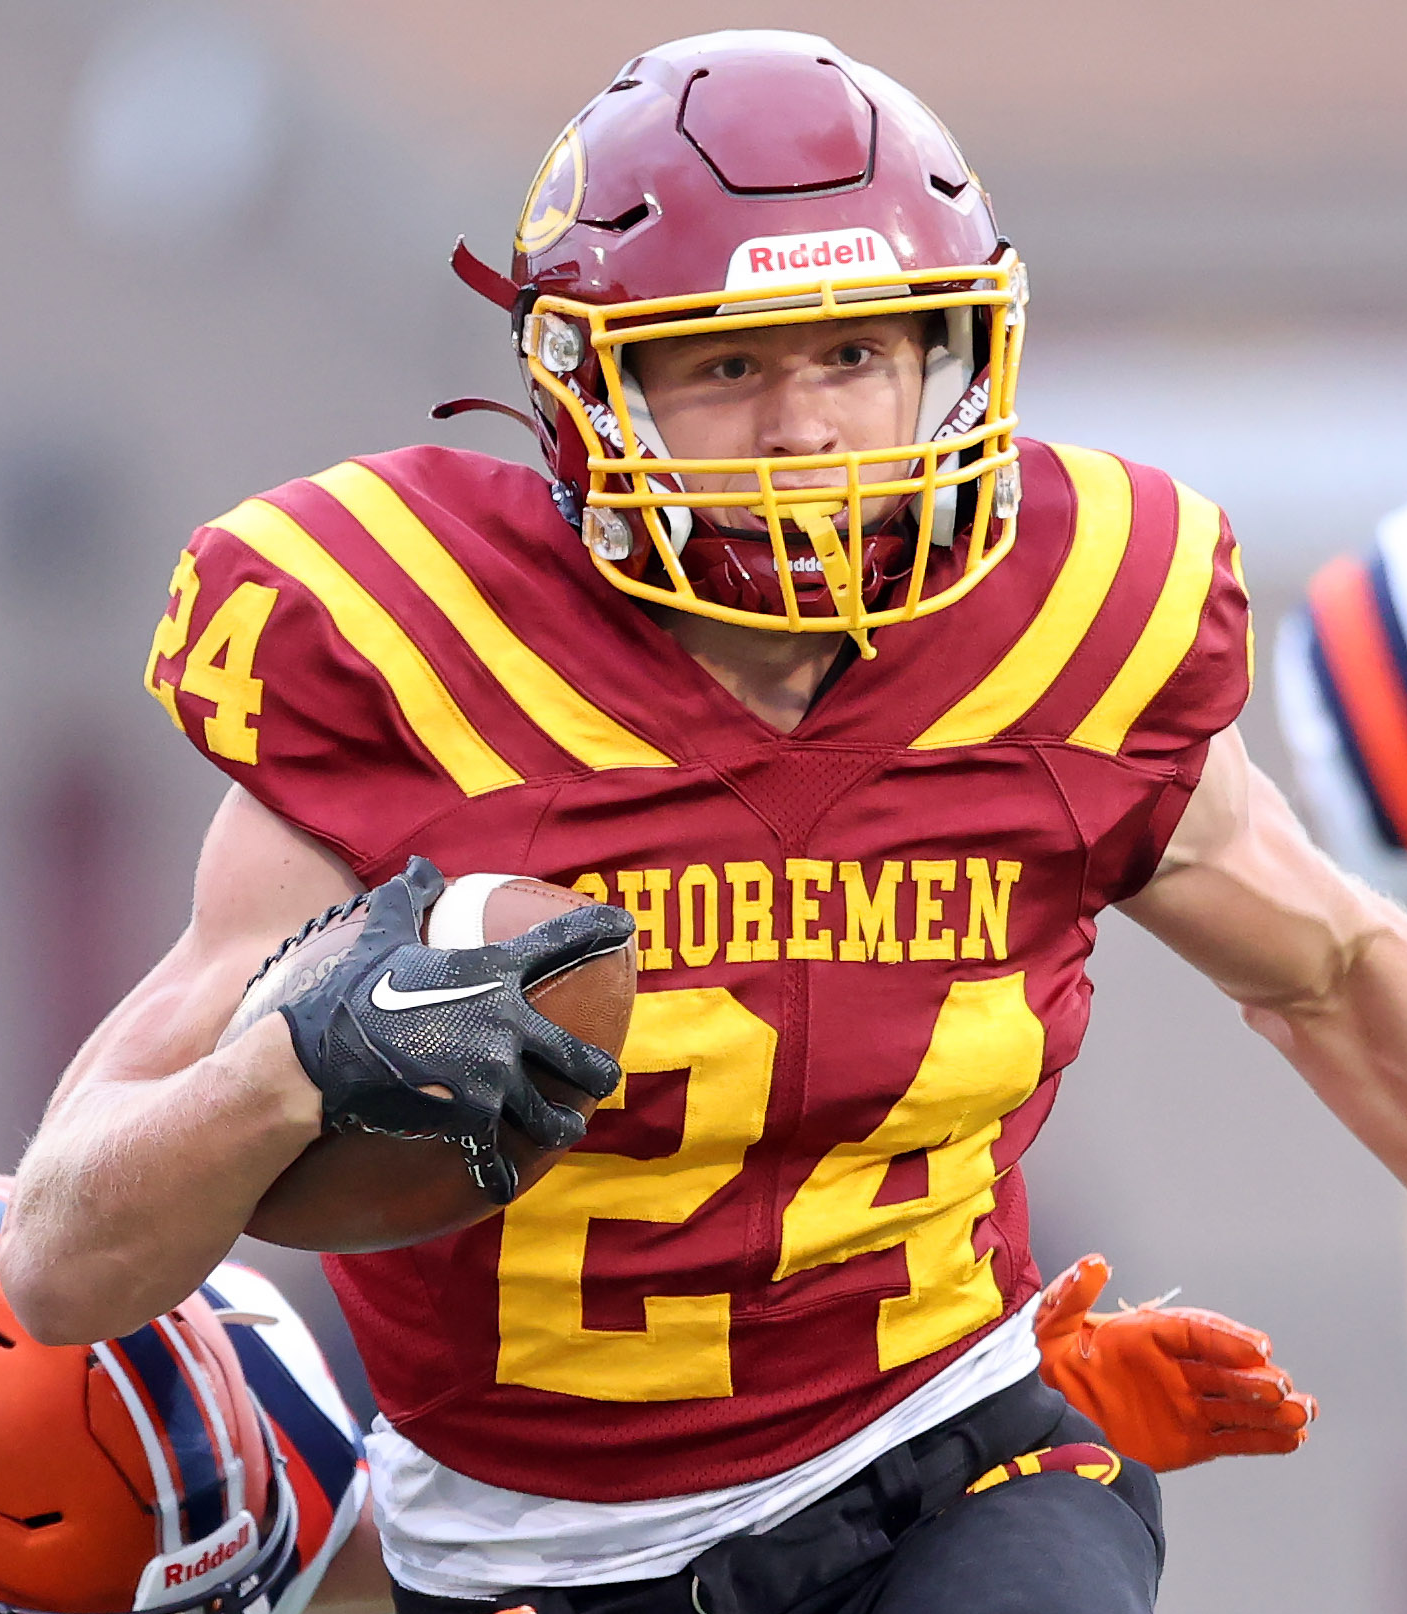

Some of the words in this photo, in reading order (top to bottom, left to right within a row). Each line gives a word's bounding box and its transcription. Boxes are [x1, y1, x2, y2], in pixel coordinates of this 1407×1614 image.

[748, 236, 875, 273] Riddell
[144, 549, 279, 766] 24
[496, 971, 1045, 1402] 24
